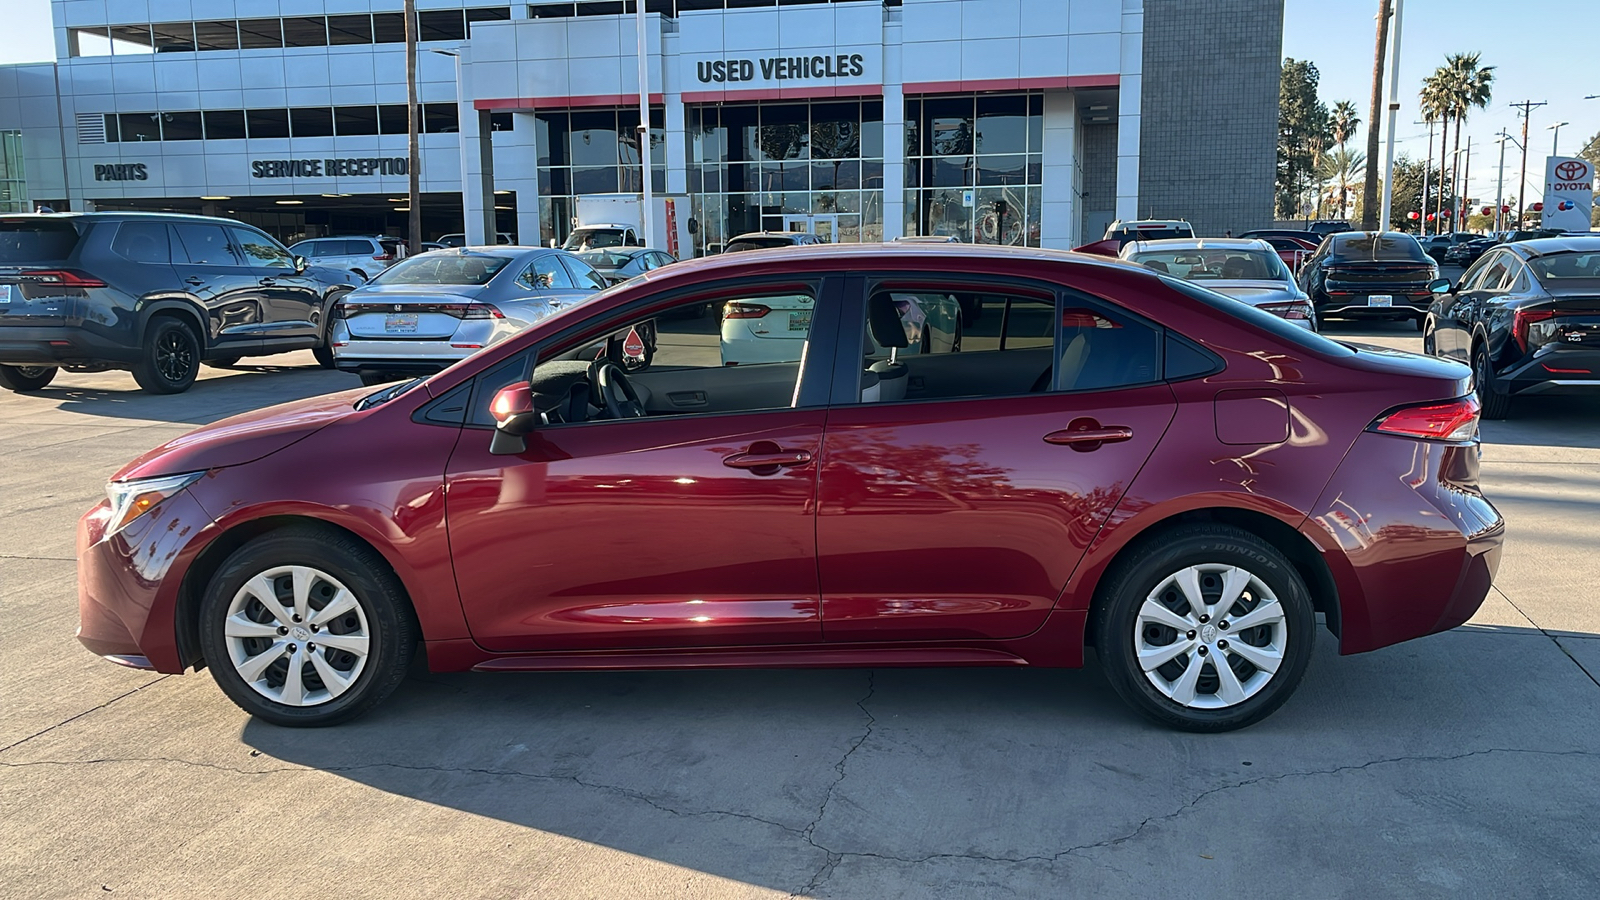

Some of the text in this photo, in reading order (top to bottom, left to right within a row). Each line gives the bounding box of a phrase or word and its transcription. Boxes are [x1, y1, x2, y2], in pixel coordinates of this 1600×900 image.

[697, 54, 863, 83] USED VEHICLES
[94, 163, 148, 181] PARTS
[252, 159, 323, 178] SERVICE
[1213, 543, 1278, 569] DUNLOP
